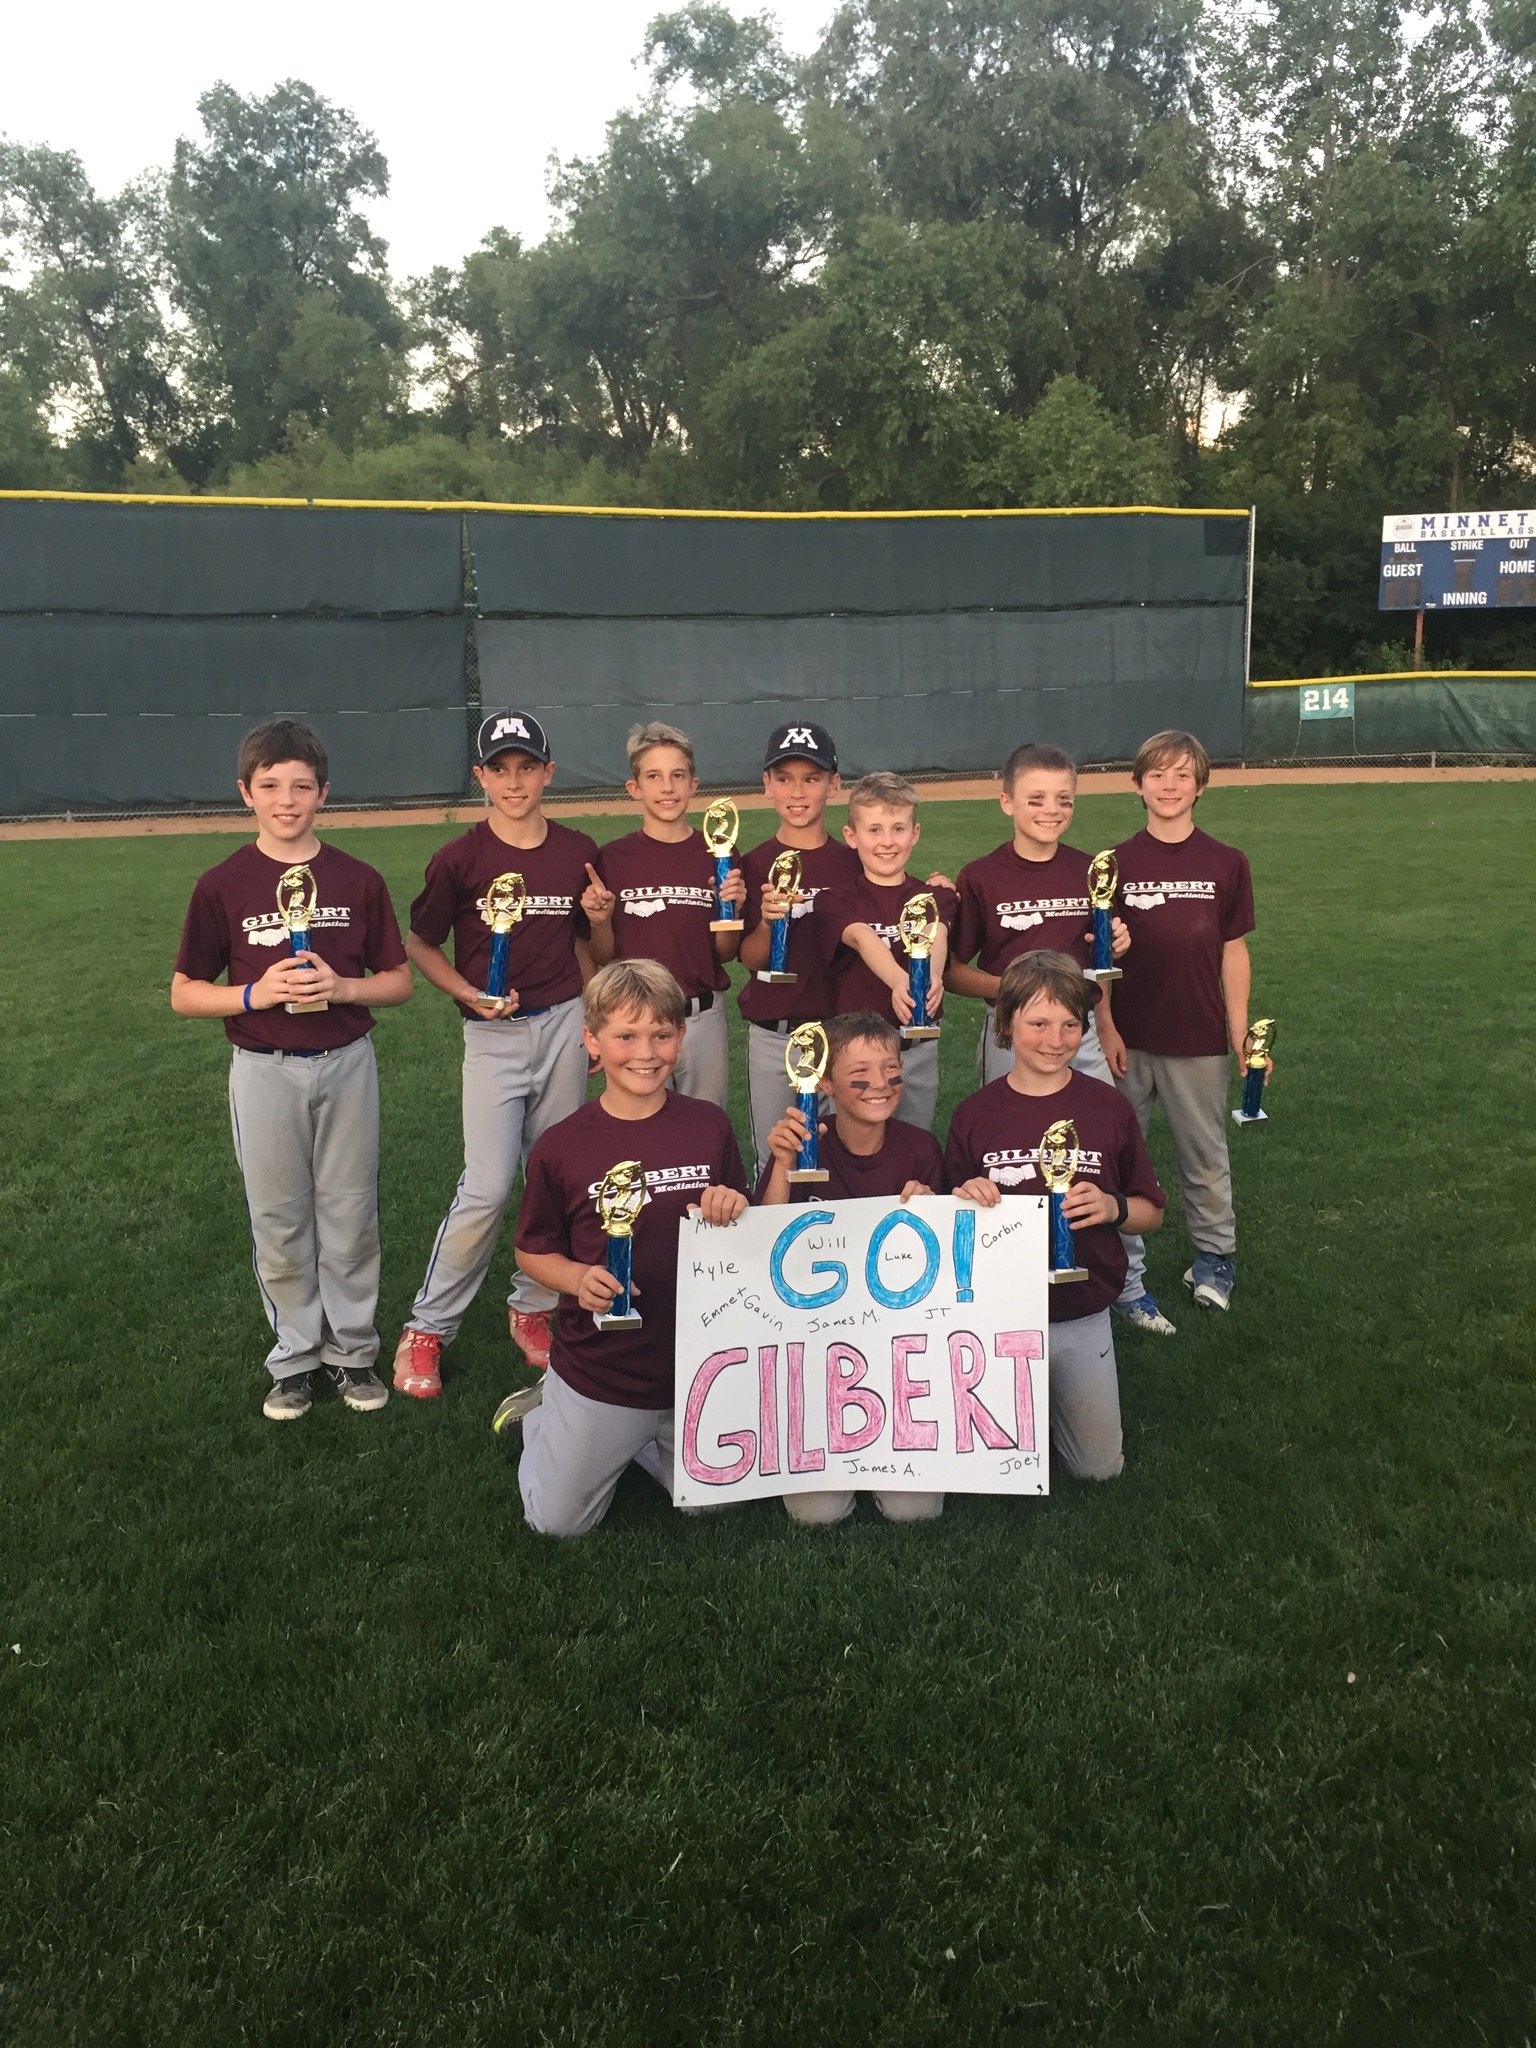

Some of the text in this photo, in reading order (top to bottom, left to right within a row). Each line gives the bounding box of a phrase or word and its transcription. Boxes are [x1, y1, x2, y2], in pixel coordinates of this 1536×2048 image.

[1421, 513, 1528, 530] MINNET
[1421, 527, 1496, 538] BASEBALL
[1507, 526, 1535, 535] ASS
[1394, 538, 1530, 553] BALL STRIKE OUT
[1383, 560, 1536, 577] GUEST HOME
[1443, 592, 1487, 606] INNING
[1304, 687, 1349, 711] 214
[490, 718, 530, 741] M
[779, 727, 818, 750] M
[620, 886, 713, 899] GILBERT
[1123, 881, 1216, 891] GILBERT
[667, 898, 712, 908] Mediation
[996, 898, 1089, 912] GILBERT
[1044, 910, 1089, 918] Mediation
[588, 1165, 710, 1194] GBERT
[654, 1177, 710, 1193] Mediation
[981, 1220, 1023, 1248] Corbin
[808, 1236, 847, 1250] Will
[770, 1208, 976, 1310] GO!
[884, 1251, 913, 1262] Luke
[693, 1261, 739, 1281] Kyle
[743, 1294, 784, 1331] Gavin
[807, 1309, 881, 1333] James M.
[924, 1307, 951, 1320] JT
[682, 1330, 1044, 1486] GILBERT
[842, 1458, 921, 1477] James A.
[999, 1453, 1041, 1475] Joey
